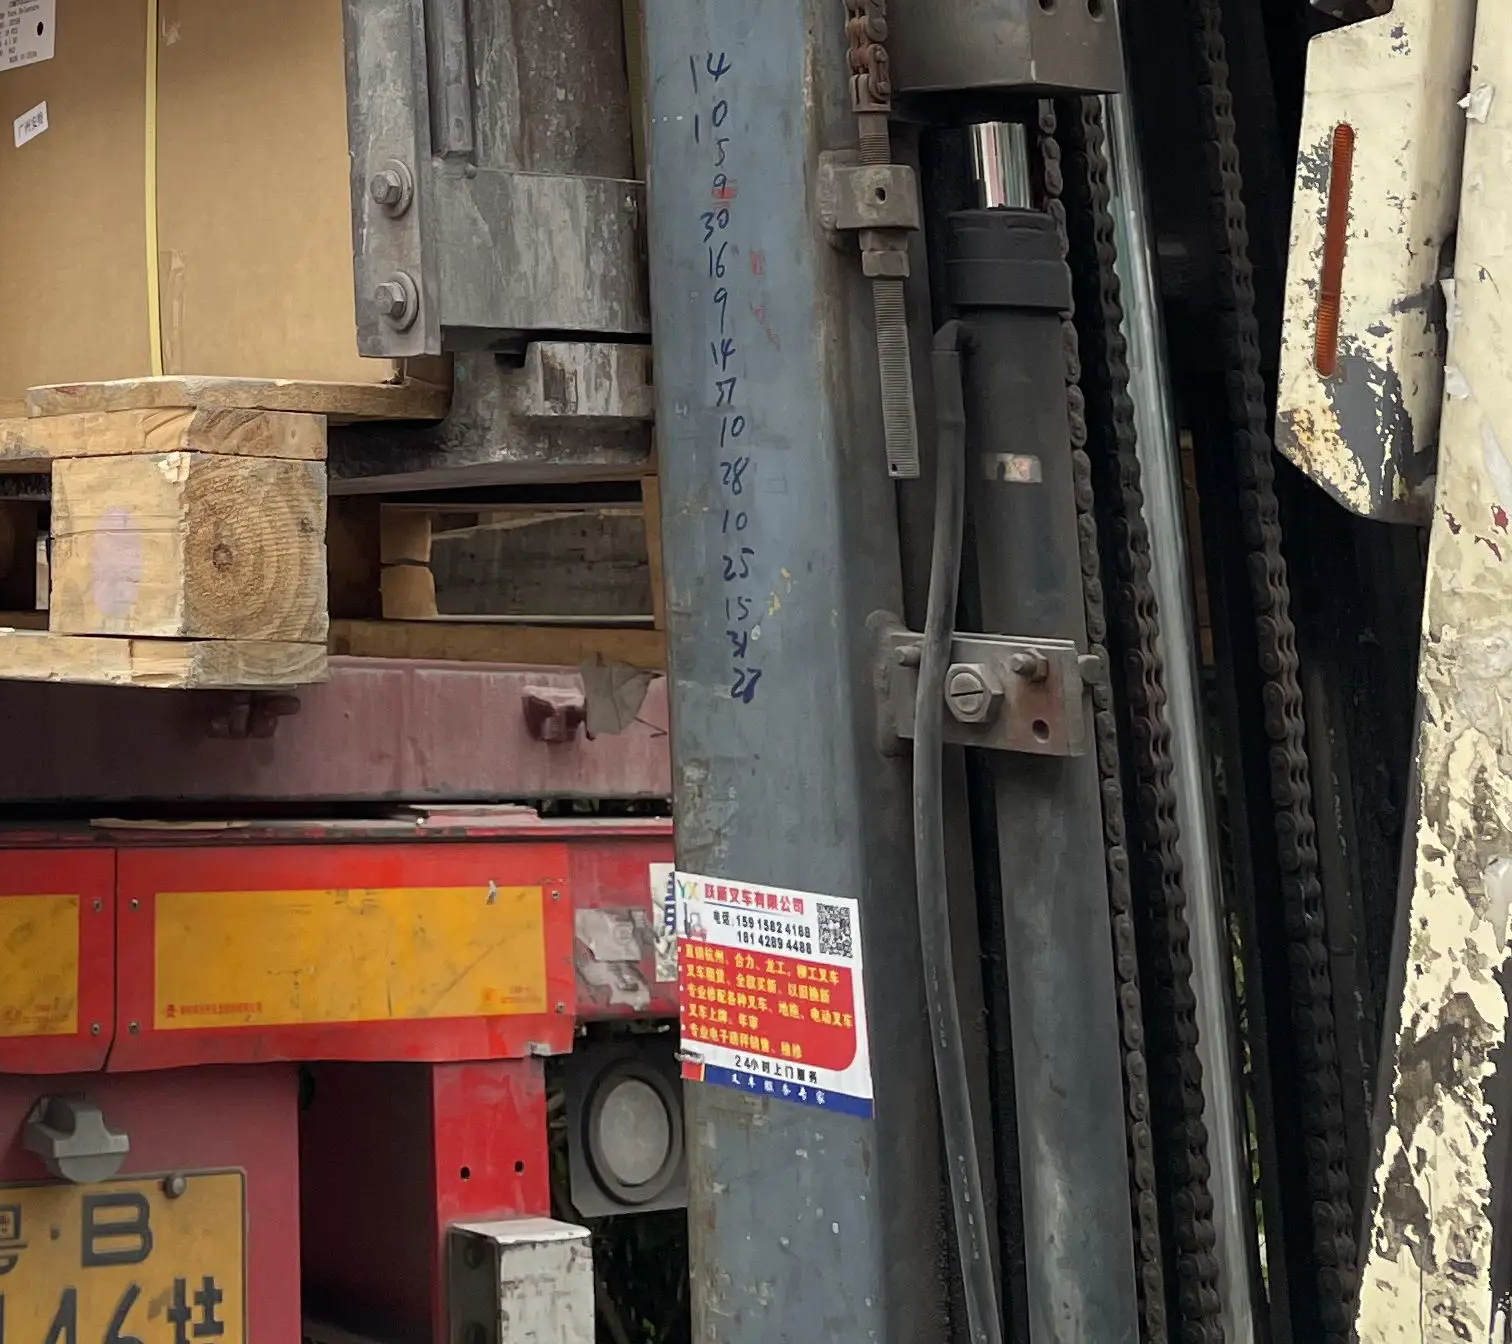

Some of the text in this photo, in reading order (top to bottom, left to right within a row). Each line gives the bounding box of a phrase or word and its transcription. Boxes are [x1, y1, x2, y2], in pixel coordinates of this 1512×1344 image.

[700, 208, 730, 243] 30
[708, 241, 728, 278] 16
[720, 415, 745, 448] 10
[720, 457, 750, 496] 28
[722, 510, 748, 534] 10
[722, 547, 755, 582] 25
[726, 596, 752, 621] 15
